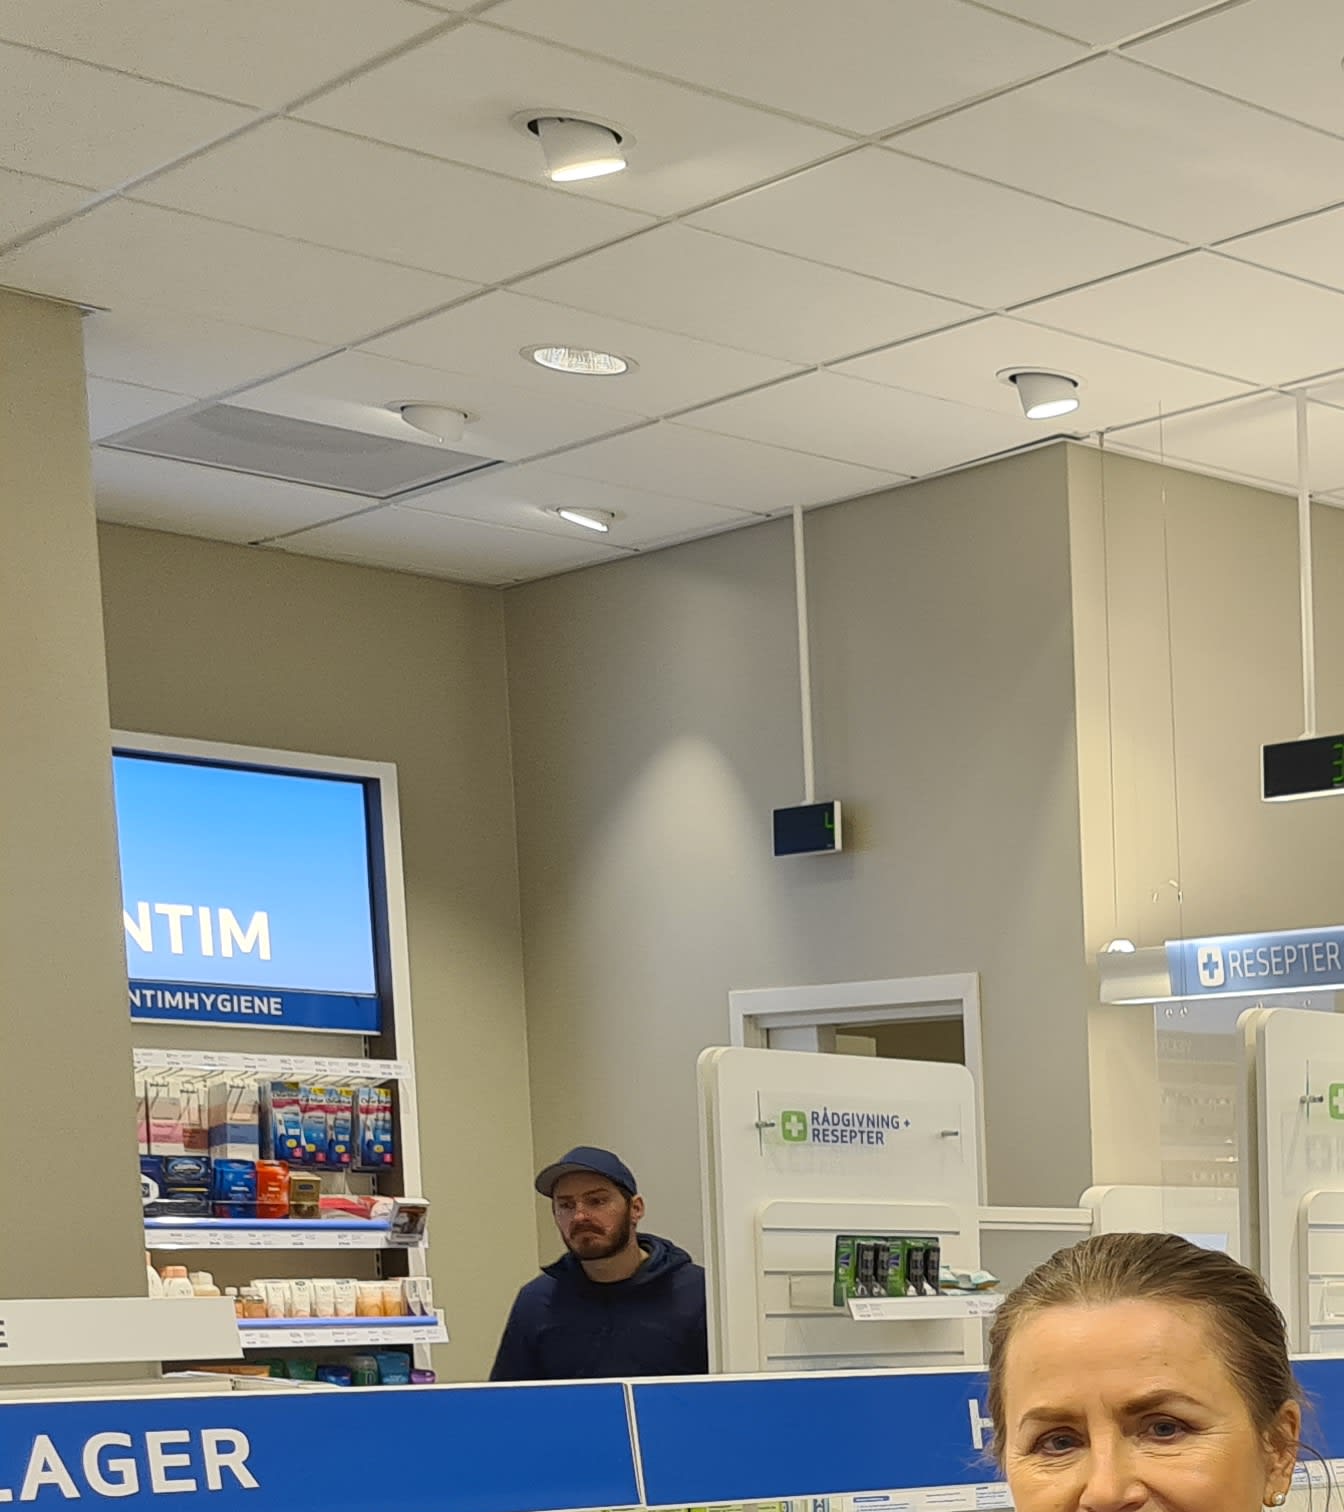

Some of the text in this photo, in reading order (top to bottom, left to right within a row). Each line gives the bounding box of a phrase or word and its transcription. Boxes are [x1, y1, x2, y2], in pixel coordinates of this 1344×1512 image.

[1228, 941, 1342, 978] RESEPTER
[811, 1107, 900, 1130] RÅDGIVNING
[812, 1128, 885, 1145] RESEPTER
[0, 1429, 260, 1502] AGER
